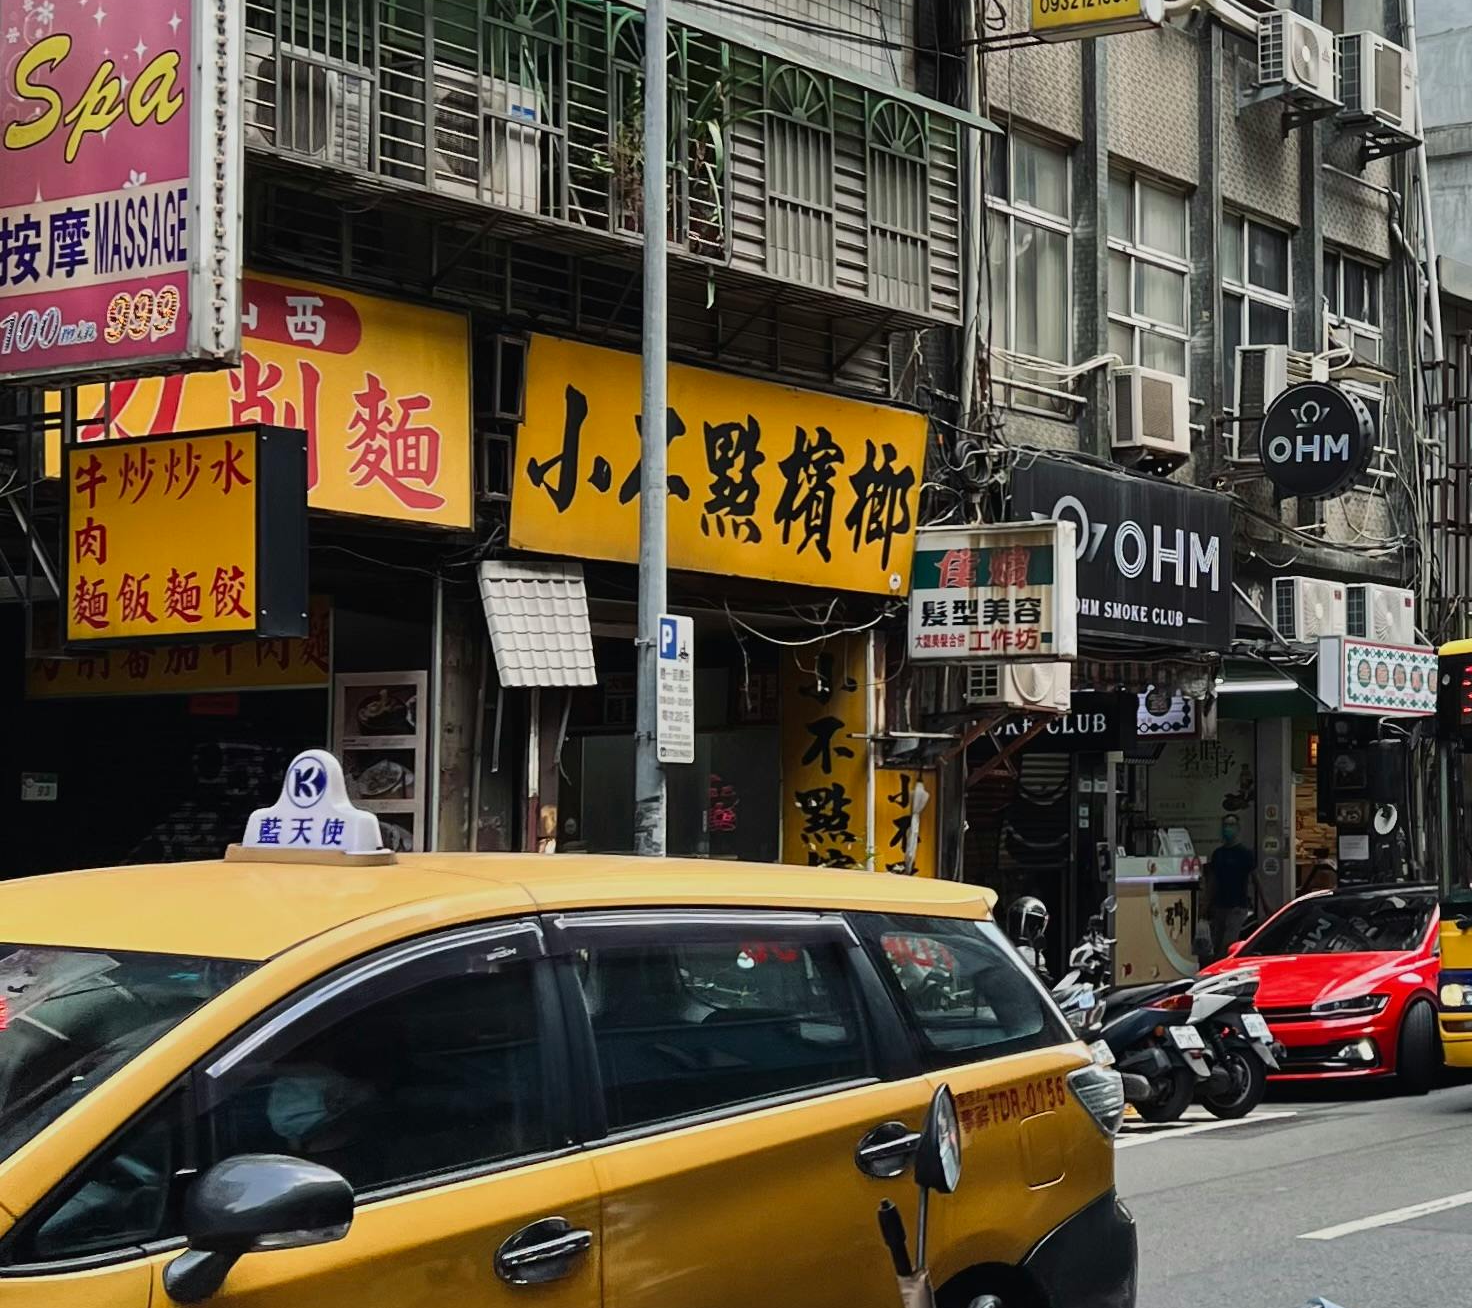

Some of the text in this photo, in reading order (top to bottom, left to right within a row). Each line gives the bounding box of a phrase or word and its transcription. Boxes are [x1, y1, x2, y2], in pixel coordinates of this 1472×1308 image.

[4, 34, 184, 164] Spa
[0, 187, 188, 289] 按摩 MASSAGE
[104, 284, 180, 344] 999
[1268, 433, 1350, 464] OHM
[73, 456, 109, 629] 牛肉麵
[116, 447, 157, 624] 炒飯
[164, 442, 203, 624] 炒麵
[210, 440, 251, 620] 水餃
[1114, 520, 1219, 591] OHM
[921, 598, 1041, 627] 髮型美容
[969, 627, 1039, 651] 工作坊
[1104, 602, 1148, 623] SMOKE
[1152, 608, 1183, 627] CLUB
[1046, 714, 1107, 735] CLUB
[257, 817, 345, 844] 藍天使
